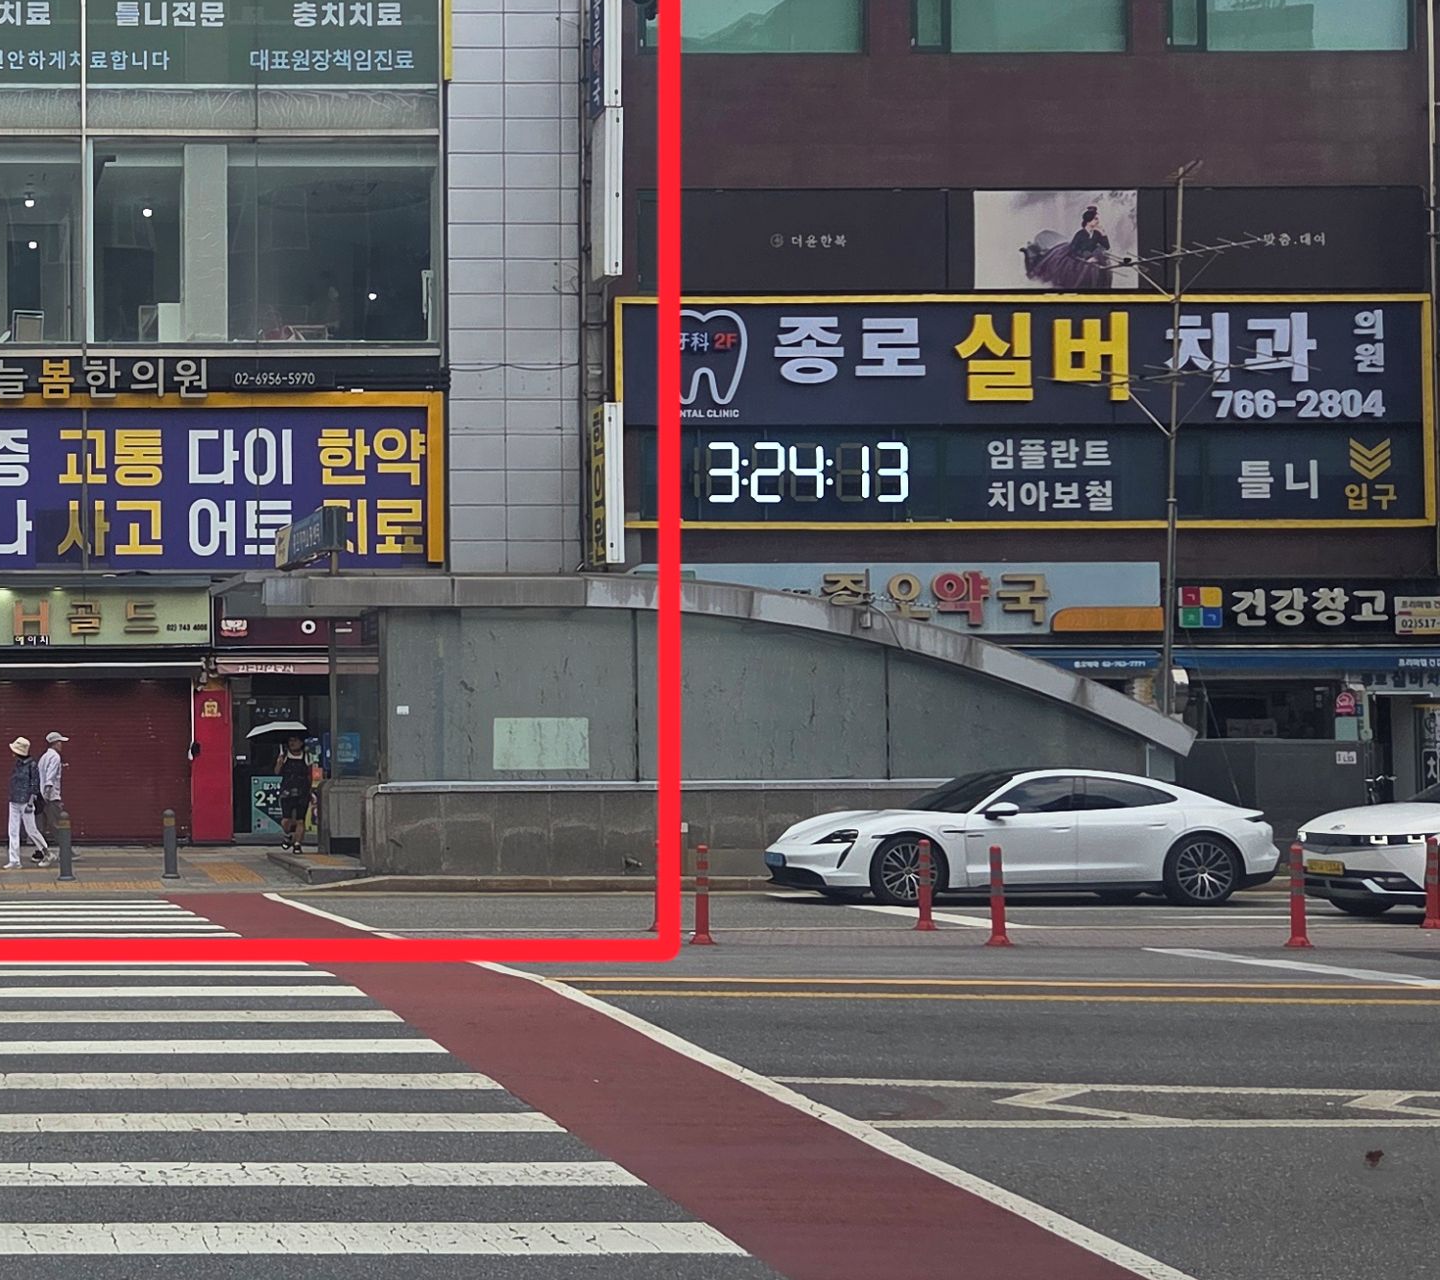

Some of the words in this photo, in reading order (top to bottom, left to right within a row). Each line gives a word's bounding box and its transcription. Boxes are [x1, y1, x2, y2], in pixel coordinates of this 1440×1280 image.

[115, 1, 226, 27] 틀니전문
[291, 1, 403, 27] 충치치료
[249, 48, 415, 71] 대표원장책임진료
[791, 234, 847, 248] 더윤한복
[713, 332, 738, 350] 2F
[773, 317, 926, 384] 종로
[955, 312, 1131, 402] 실버
[1164, 312, 1317, 383] 치과
[1353, 309, 1385, 373] 의원
[234, 372, 316, 386] 02-6956-5970
[680, 409, 705, 418] NTAL
[707, 409, 740, 418] CLINIC
[1212, 389, 1386, 419] 766-2804
[58, 429, 163, 487] 교통
[188, 428, 293, 485] 다이
[317, 428, 426, 487] 한약
[987, 438, 1112, 470] 임플란트
[708, 441, 909, 503] 3:24:13
[1237, 459, 1319, 500] 틀니
[987, 480, 1114, 513] 치아보철
[1344, 484, 1397, 511] 입구
[57, 500, 163, 557] 사고
[188, 498, 293, 557] 어트
[1231, 587, 1389, 627] 건강창고
